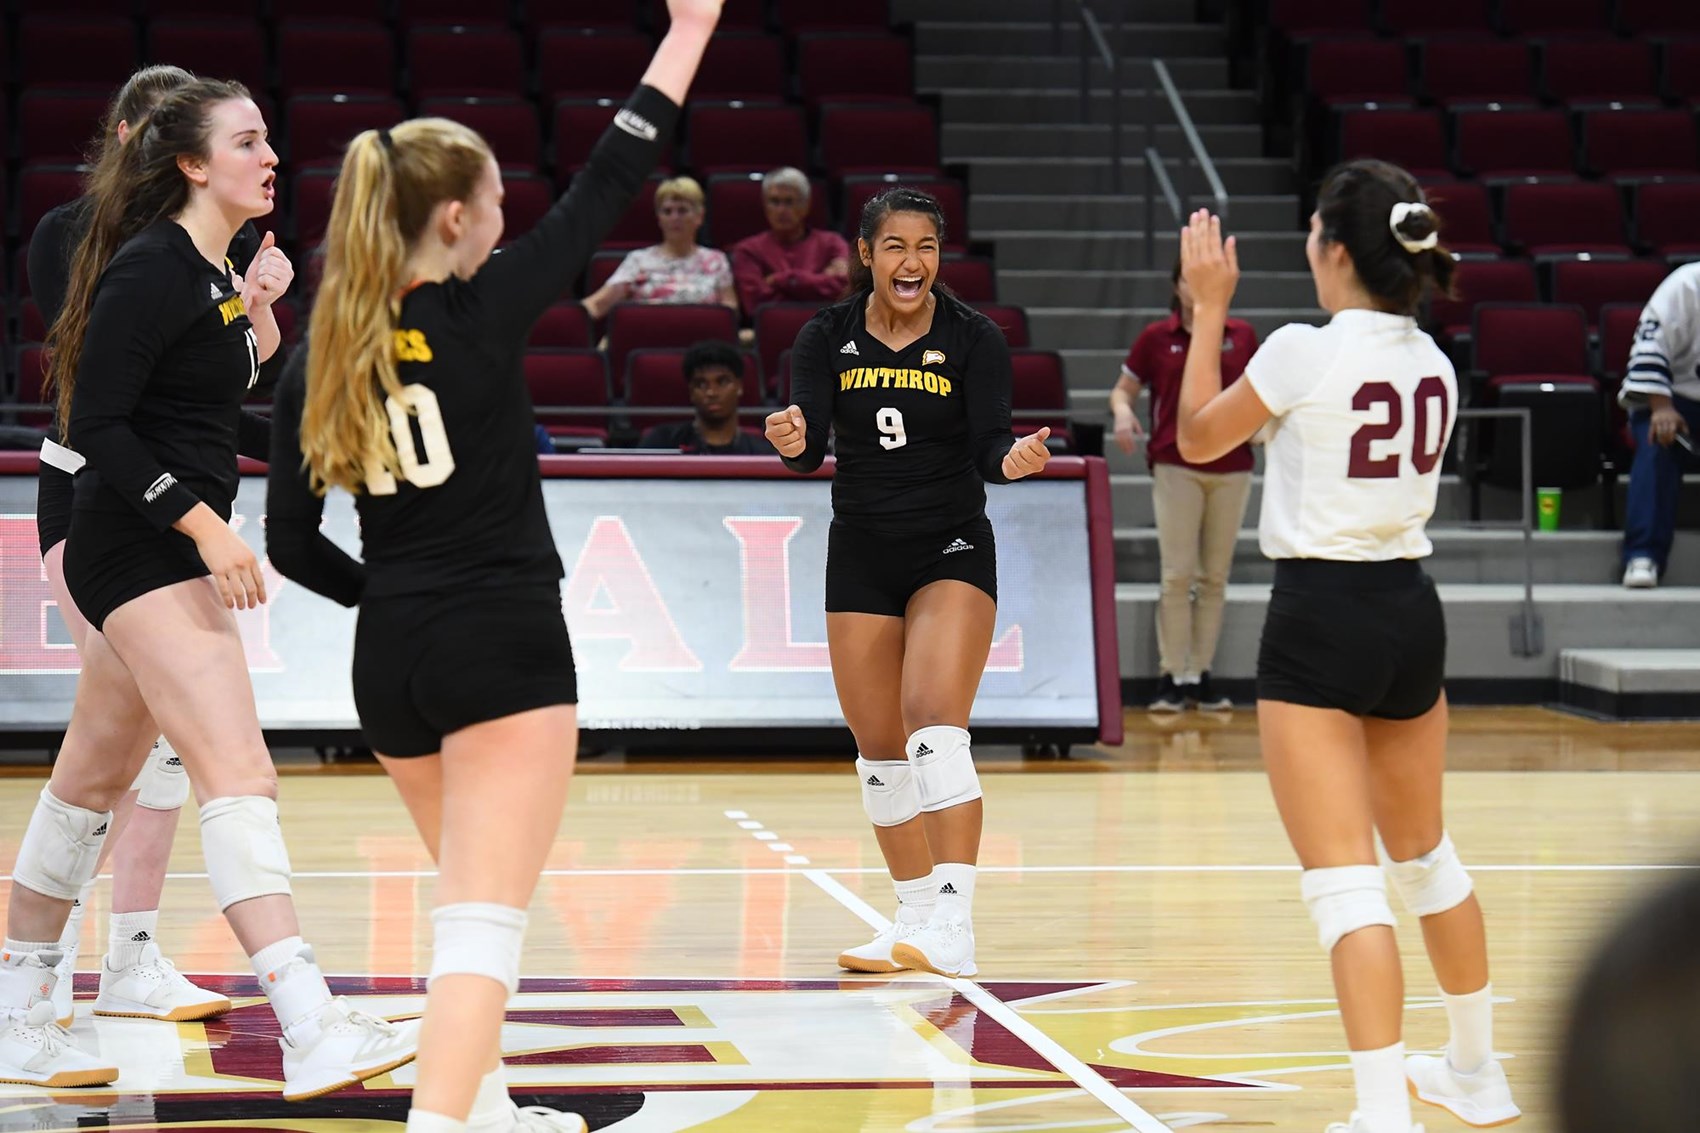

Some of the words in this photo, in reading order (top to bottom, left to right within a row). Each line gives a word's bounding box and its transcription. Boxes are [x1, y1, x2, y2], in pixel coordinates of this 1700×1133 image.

[393, 328, 433, 362] ES
[839, 367, 952, 397] WINTHROP
[365, 382, 456, 496] 0
[876, 407, 907, 450] 9
[1347, 376, 1449, 478] 20
[942, 544, 974, 554] adidas
